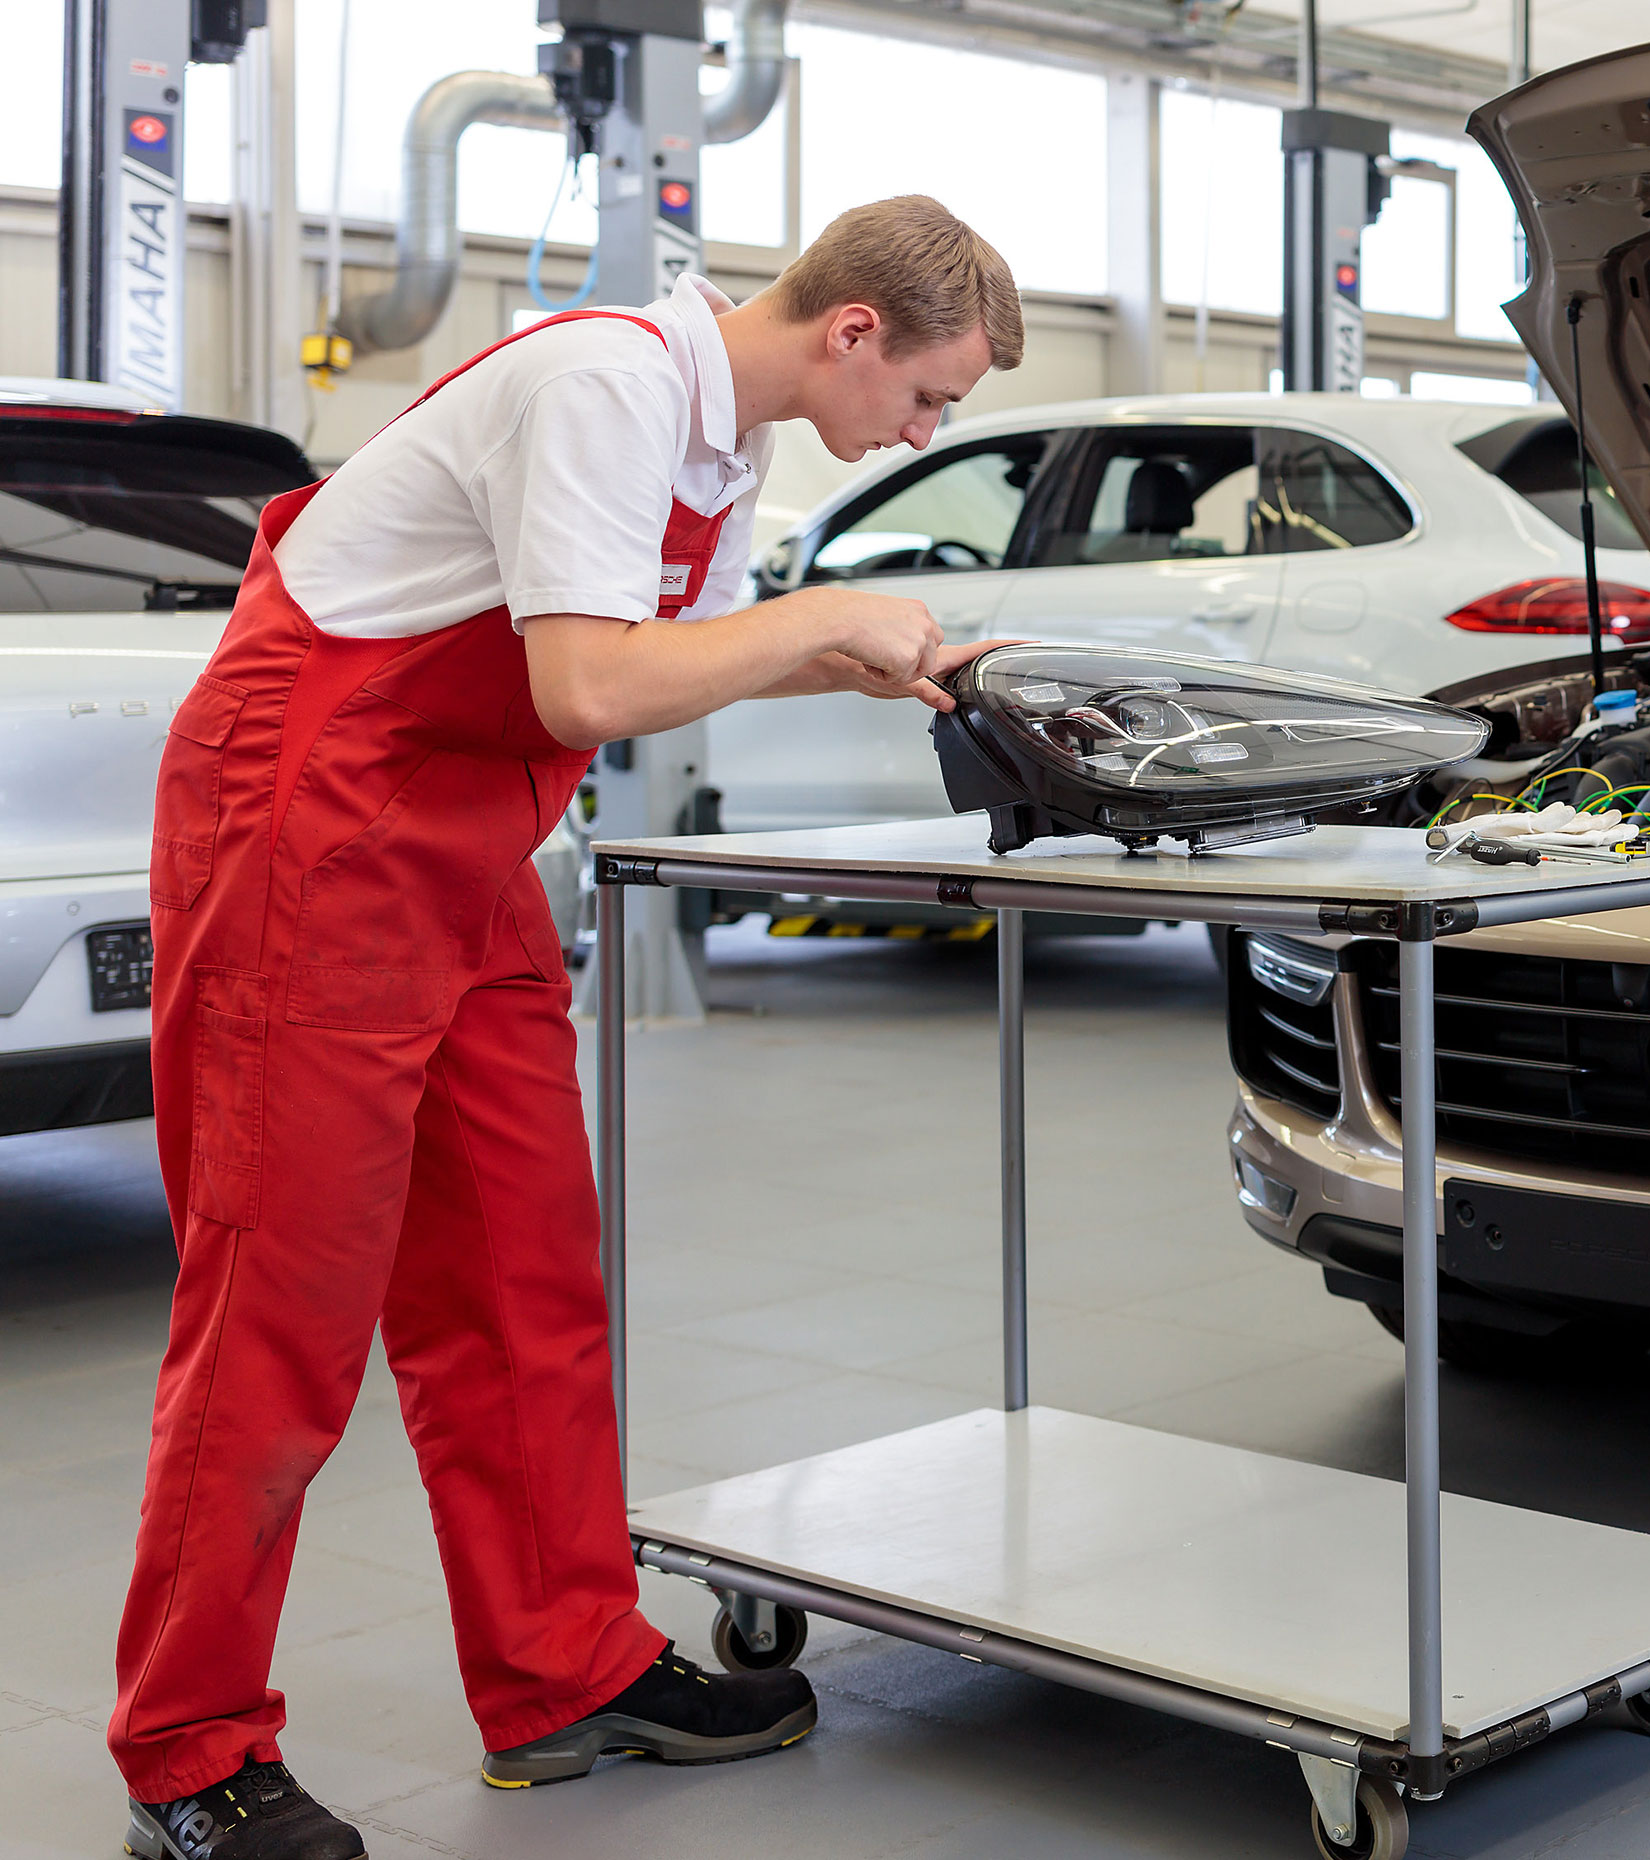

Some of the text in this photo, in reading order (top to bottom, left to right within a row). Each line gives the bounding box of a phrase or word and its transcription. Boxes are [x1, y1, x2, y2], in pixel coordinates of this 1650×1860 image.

[129, 202, 166, 375] MAHA
[261, 1790, 284, 1803] uvex
[160, 1799, 236, 1860] vex
